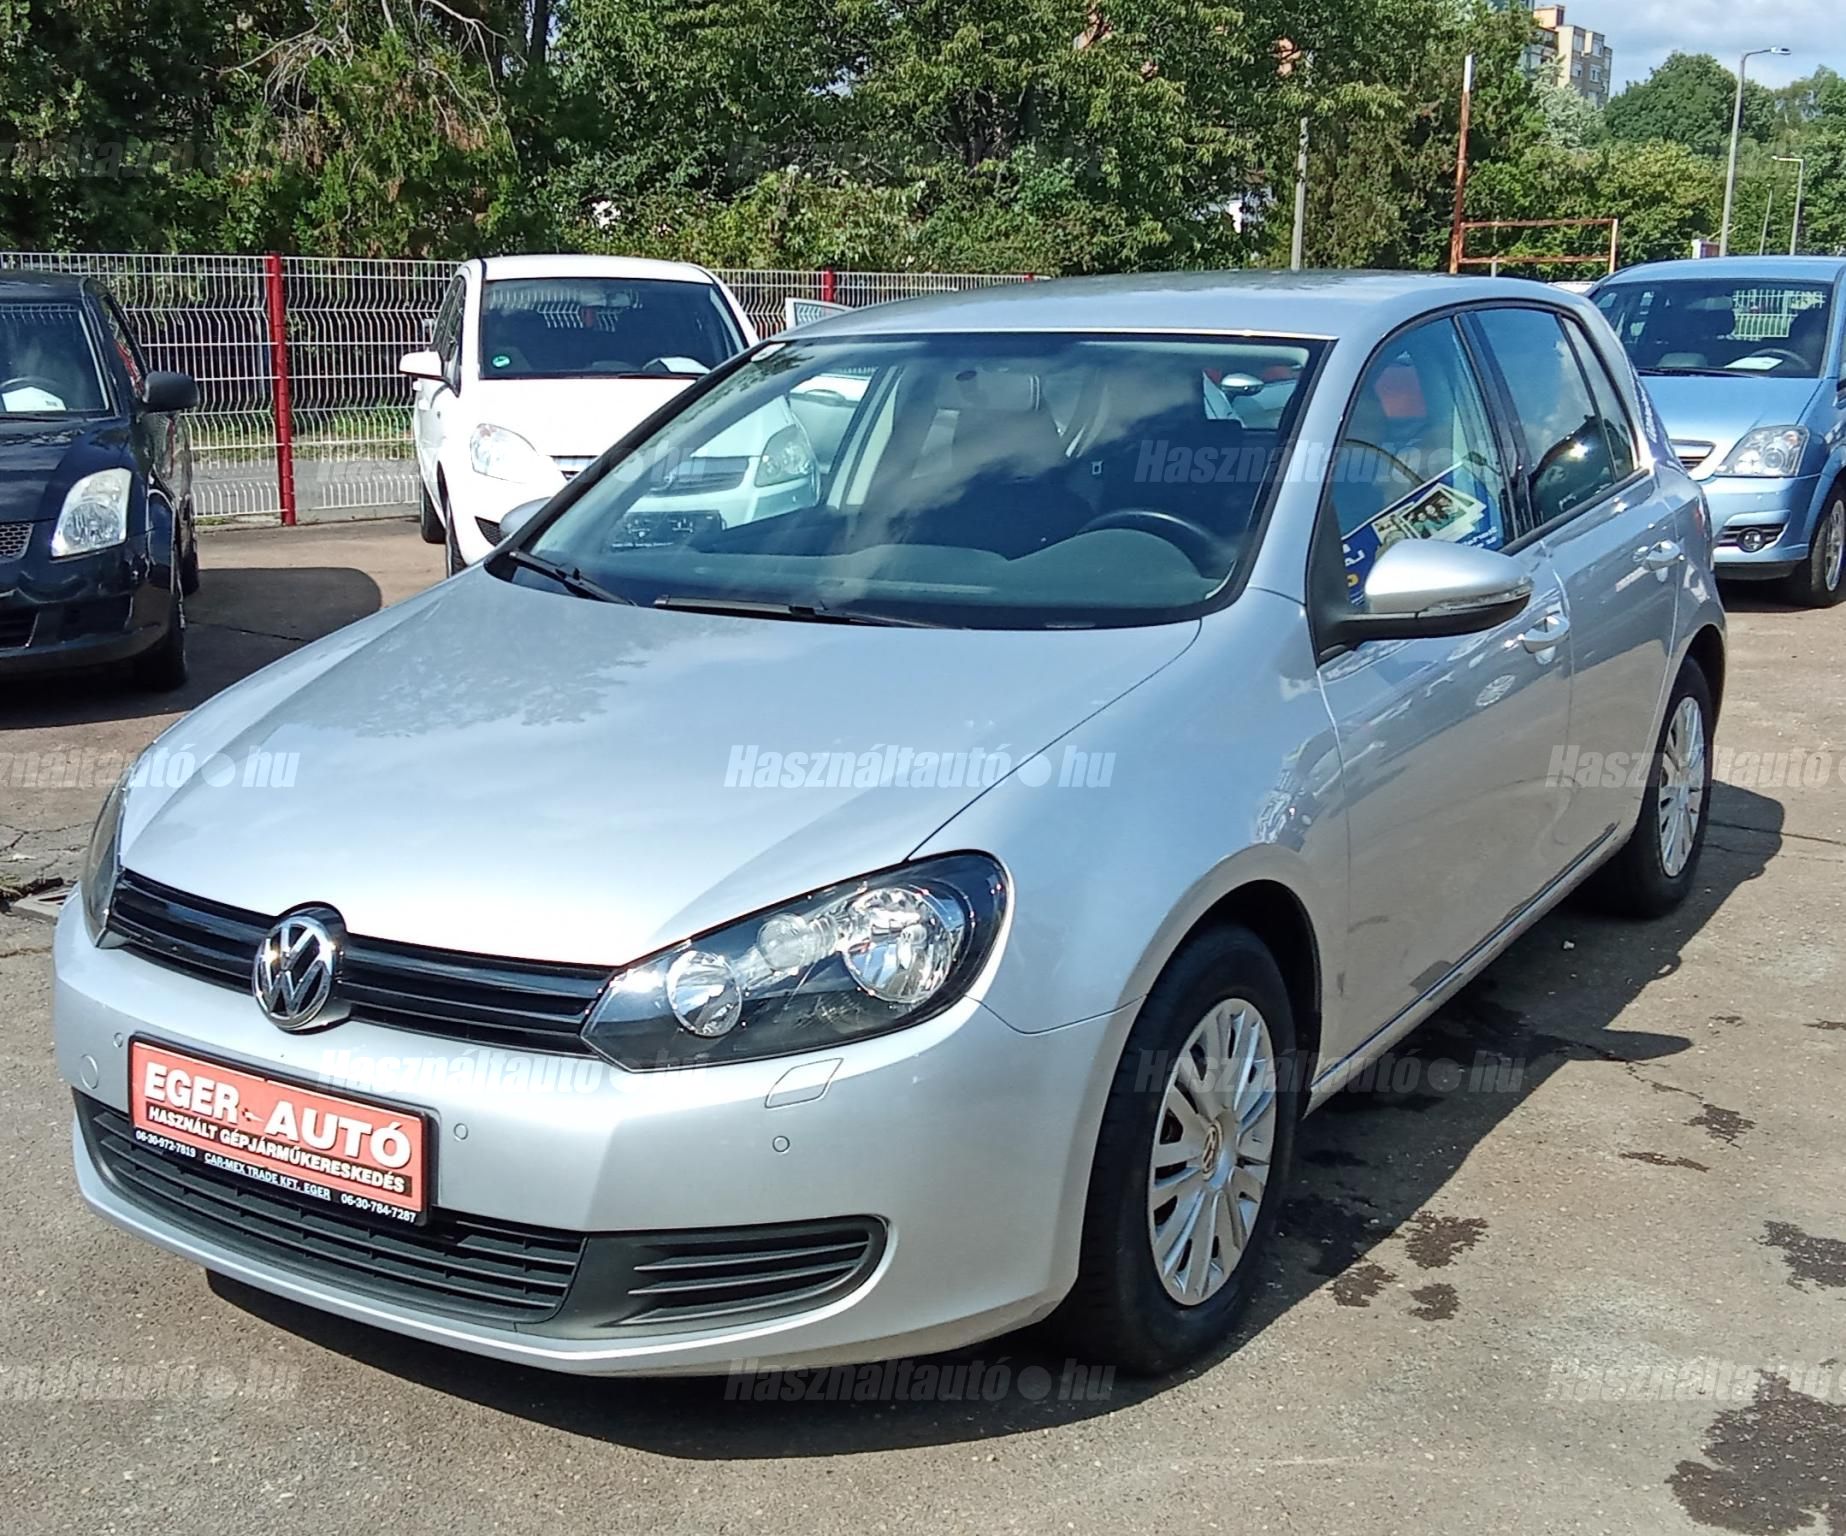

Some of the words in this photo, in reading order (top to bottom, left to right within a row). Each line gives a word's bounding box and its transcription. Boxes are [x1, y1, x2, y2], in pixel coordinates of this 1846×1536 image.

[149, 1105, 219, 1139] HASZNÁLT
[219, 1129, 406, 1193] GÉPJÁRMŰKERESKEDÉS
[204, 1152, 245, 1177] CAR-MEX
[246, 1165, 279, 1186] TRADE
[303, 1182, 331, 1200] EGER
[340, 1193, 417, 1223] 06-30-784-7287
